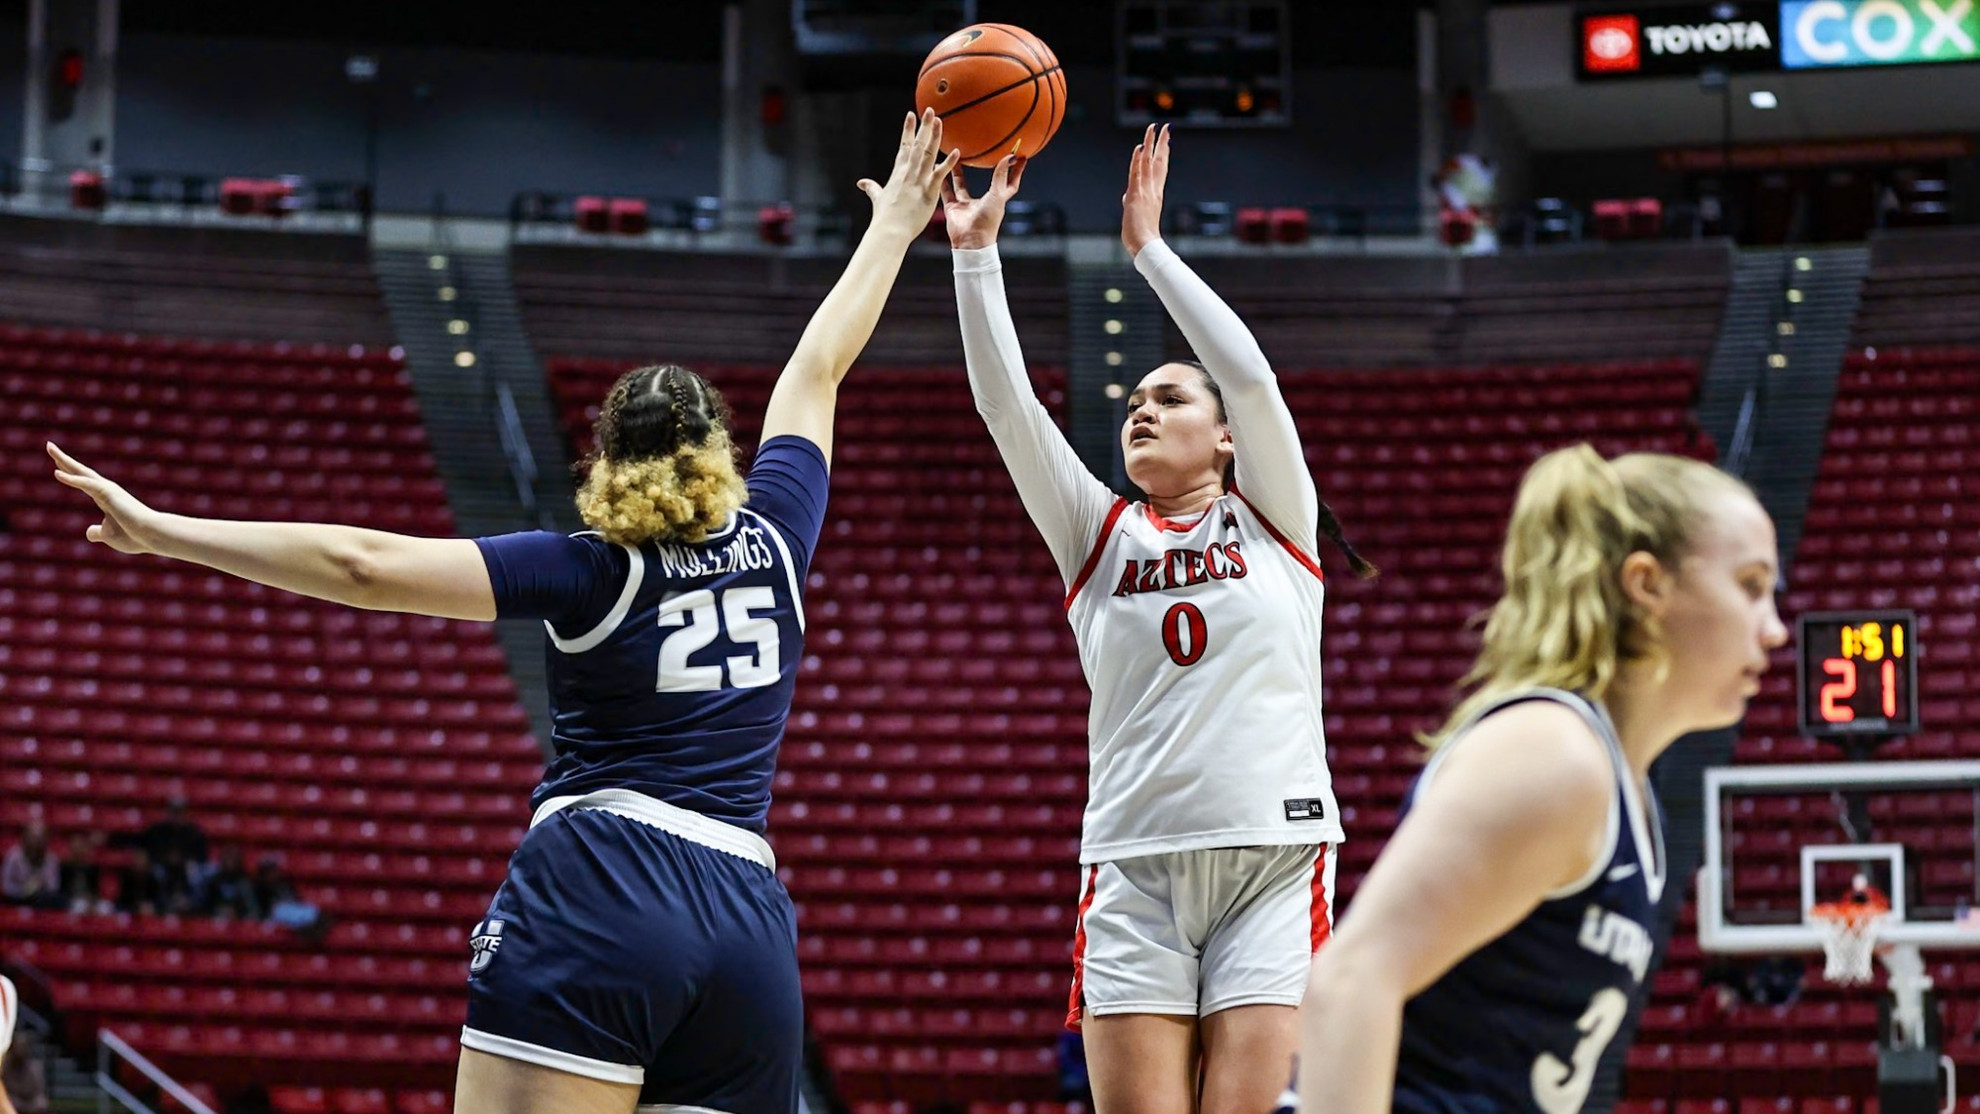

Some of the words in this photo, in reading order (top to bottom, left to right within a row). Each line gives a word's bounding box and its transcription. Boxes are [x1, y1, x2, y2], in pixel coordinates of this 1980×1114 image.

[1645, 21, 1771, 55] TOYOTA
[1796, 0, 1976, 62] COX
[1112, 541, 1248, 597] AZTECS
[656, 586, 781, 692] 25
[1162, 602, 1208, 666] 0
[1841, 622, 1904, 662] 1:51
[1820, 658, 1896, 722] 21
[1310, 803, 1321, 813] XL
[1531, 987, 1627, 1114] 3
